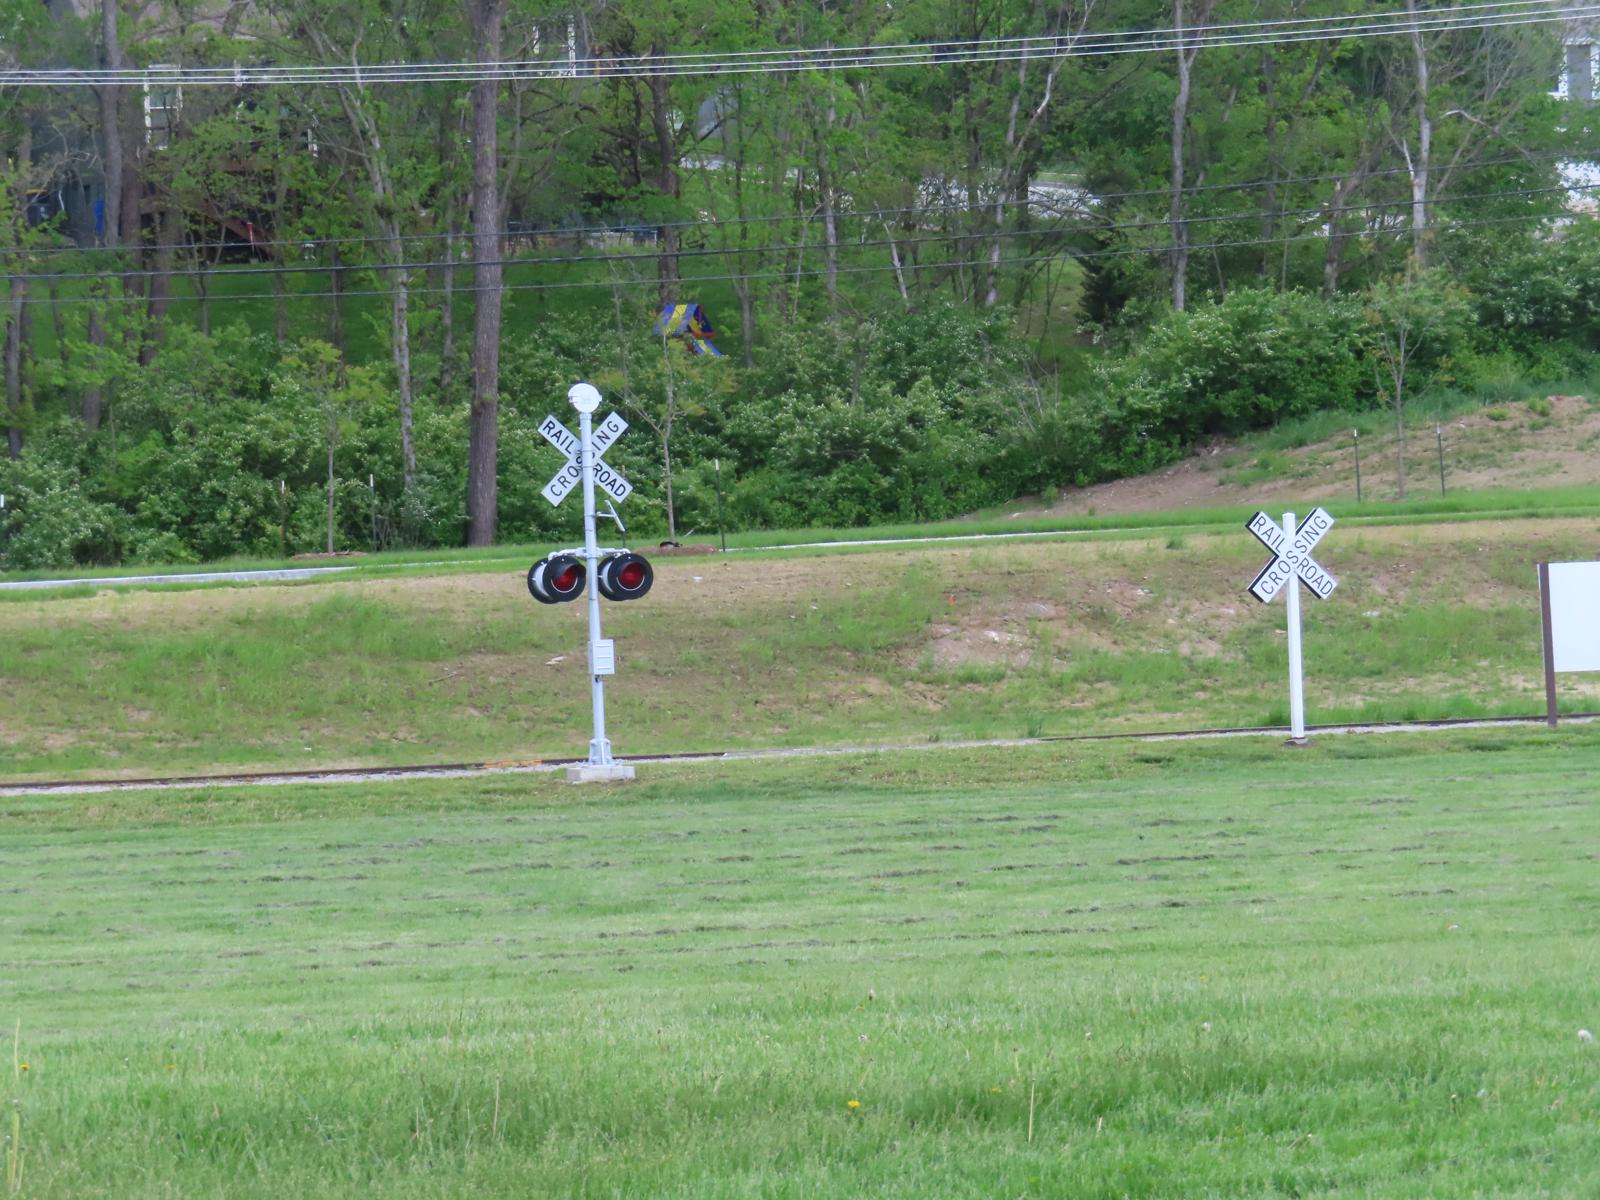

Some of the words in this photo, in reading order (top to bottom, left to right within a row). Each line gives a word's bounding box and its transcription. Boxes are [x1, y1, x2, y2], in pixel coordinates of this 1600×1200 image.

[542, 420, 574, 455] RAIL
[592, 462, 626, 497] ROAD
[550, 420, 619, 497] CROING
[1253, 515, 1285, 554] RAIL
[1297, 557, 1333, 595] ROAD
[1260, 515, 1328, 595] CROSSING
